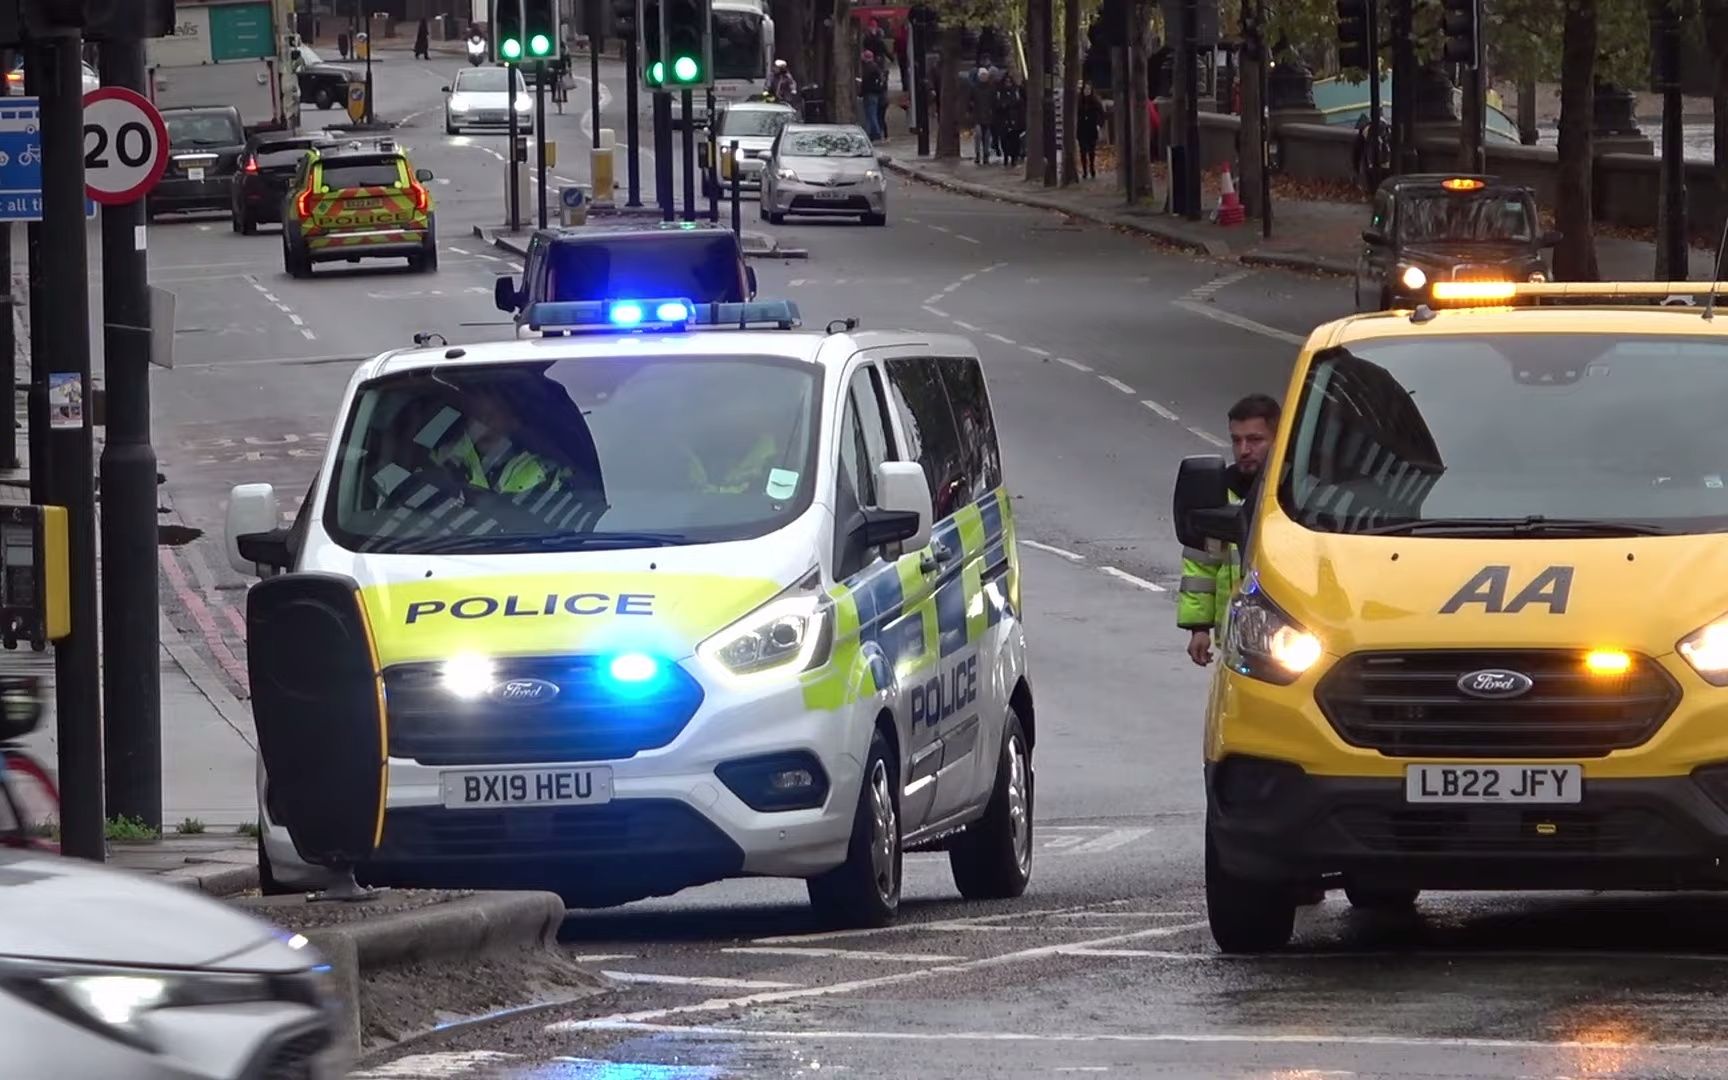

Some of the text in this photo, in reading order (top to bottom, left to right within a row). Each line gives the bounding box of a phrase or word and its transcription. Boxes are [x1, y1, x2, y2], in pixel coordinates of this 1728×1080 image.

[84, 122, 152, 168] 20
[8, 198, 27, 212] all
[319, 212, 408, 227] POLICE
[1438, 565, 1575, 614] AA
[405, 593, 656, 625] POLICE
[502, 681, 544, 699] Ford
[911, 654, 977, 736] POLICE
[1472, 673, 1515, 690] Ford
[464, 771, 593, 803] BX19 HEU
[1420, 768, 1569, 798] LB22 JFY
